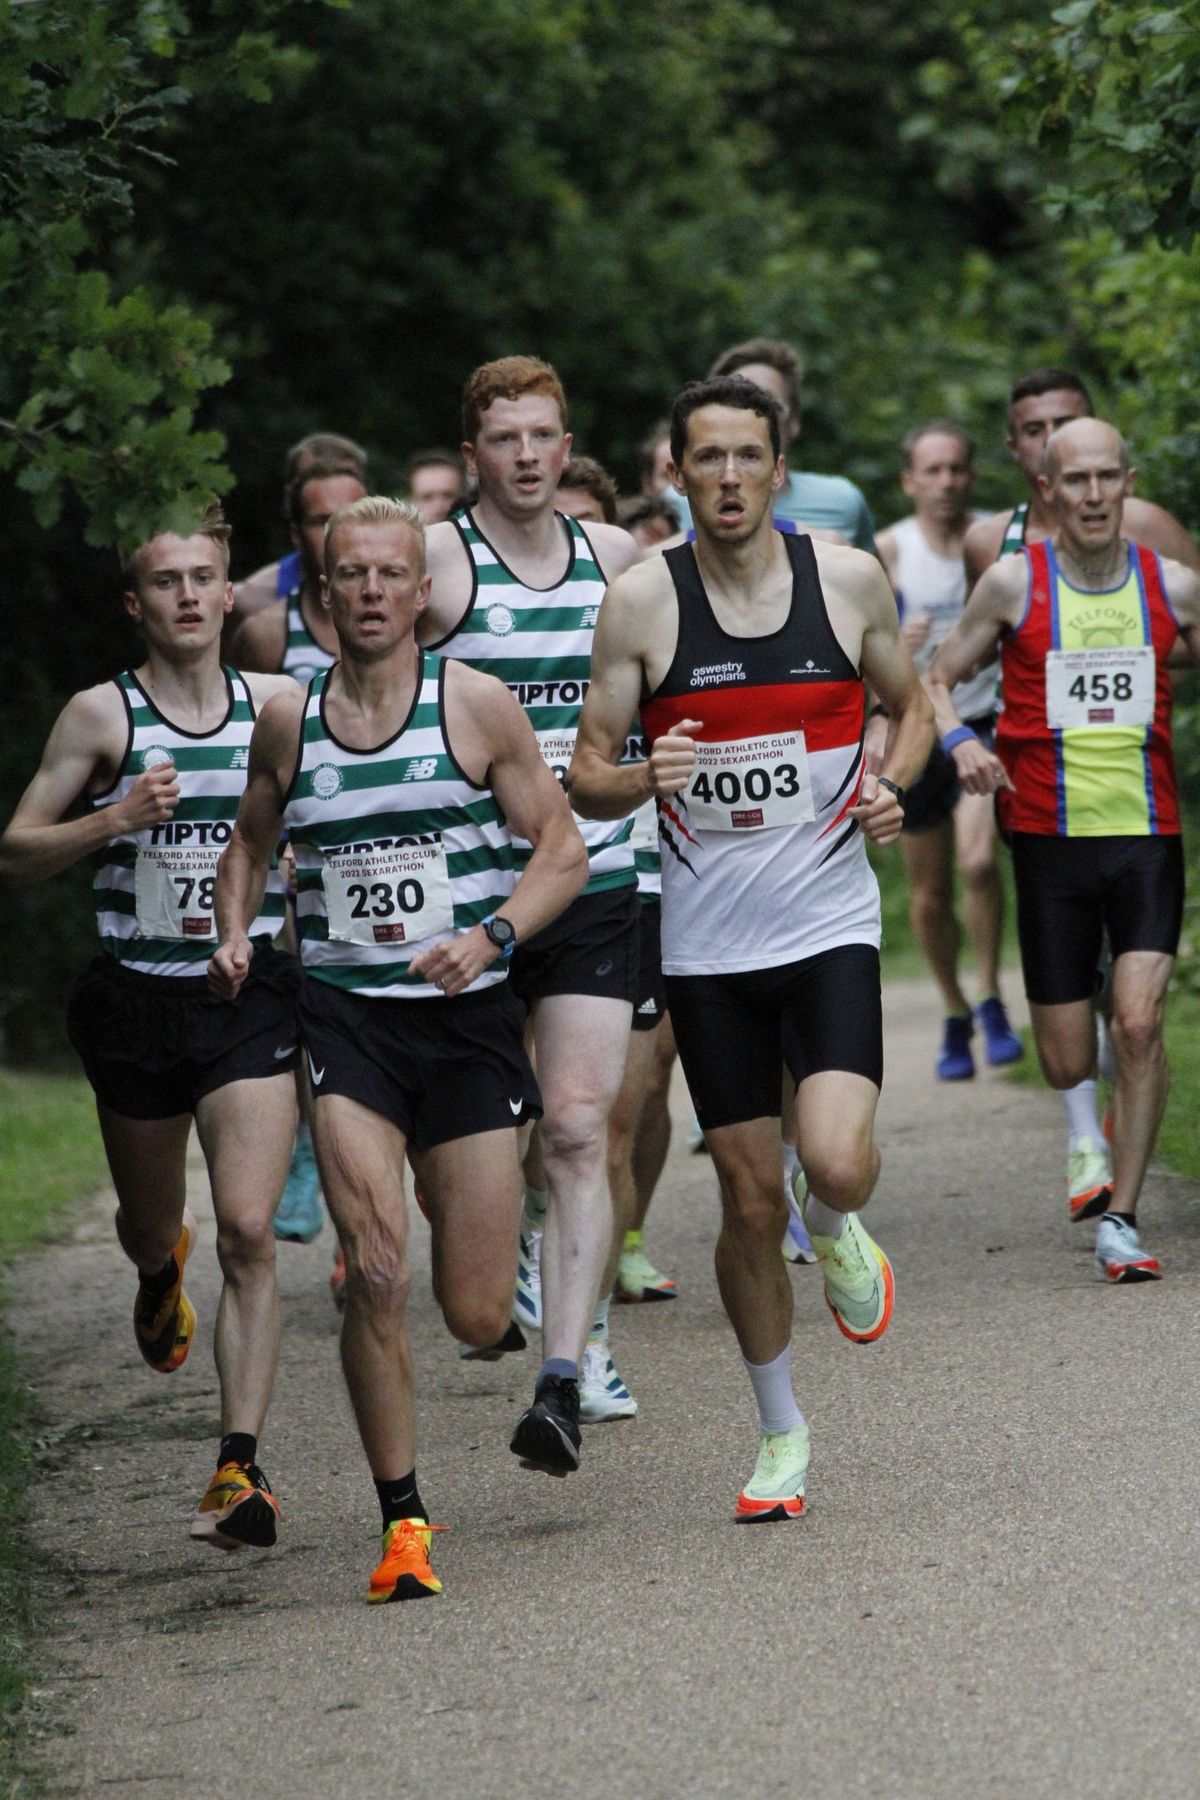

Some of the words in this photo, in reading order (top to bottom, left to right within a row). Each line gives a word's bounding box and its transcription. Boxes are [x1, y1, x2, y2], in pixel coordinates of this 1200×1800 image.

[1068, 609, 1137, 631] TELFORD
[693, 661, 743, 676] oswestry
[690, 671, 746, 687] olympians
[1068, 673, 1133, 702] 458
[695, 747, 722, 755] FORD
[725, 742, 769, 754] ATHLETIC
[771, 737, 796, 747] CLUB
[720, 750, 784, 765] SEXARATHON
[691, 764, 800, 804] 4003
[150, 822, 232, 845] TIPTO
[143, 851, 183, 859] TELFORD
[186, 851, 222, 859] ATHLET
[328, 860, 363, 870] TELFORD
[365, 853, 409, 866] ATHLETIC
[412, 850, 437, 859] CLUB
[156, 861, 178, 870] 2022
[340, 870, 360, 878] 2022
[362, 863, 425, 877] SEXARATHON
[174, 877, 217, 910] 78
[347, 878, 425, 919] 230
